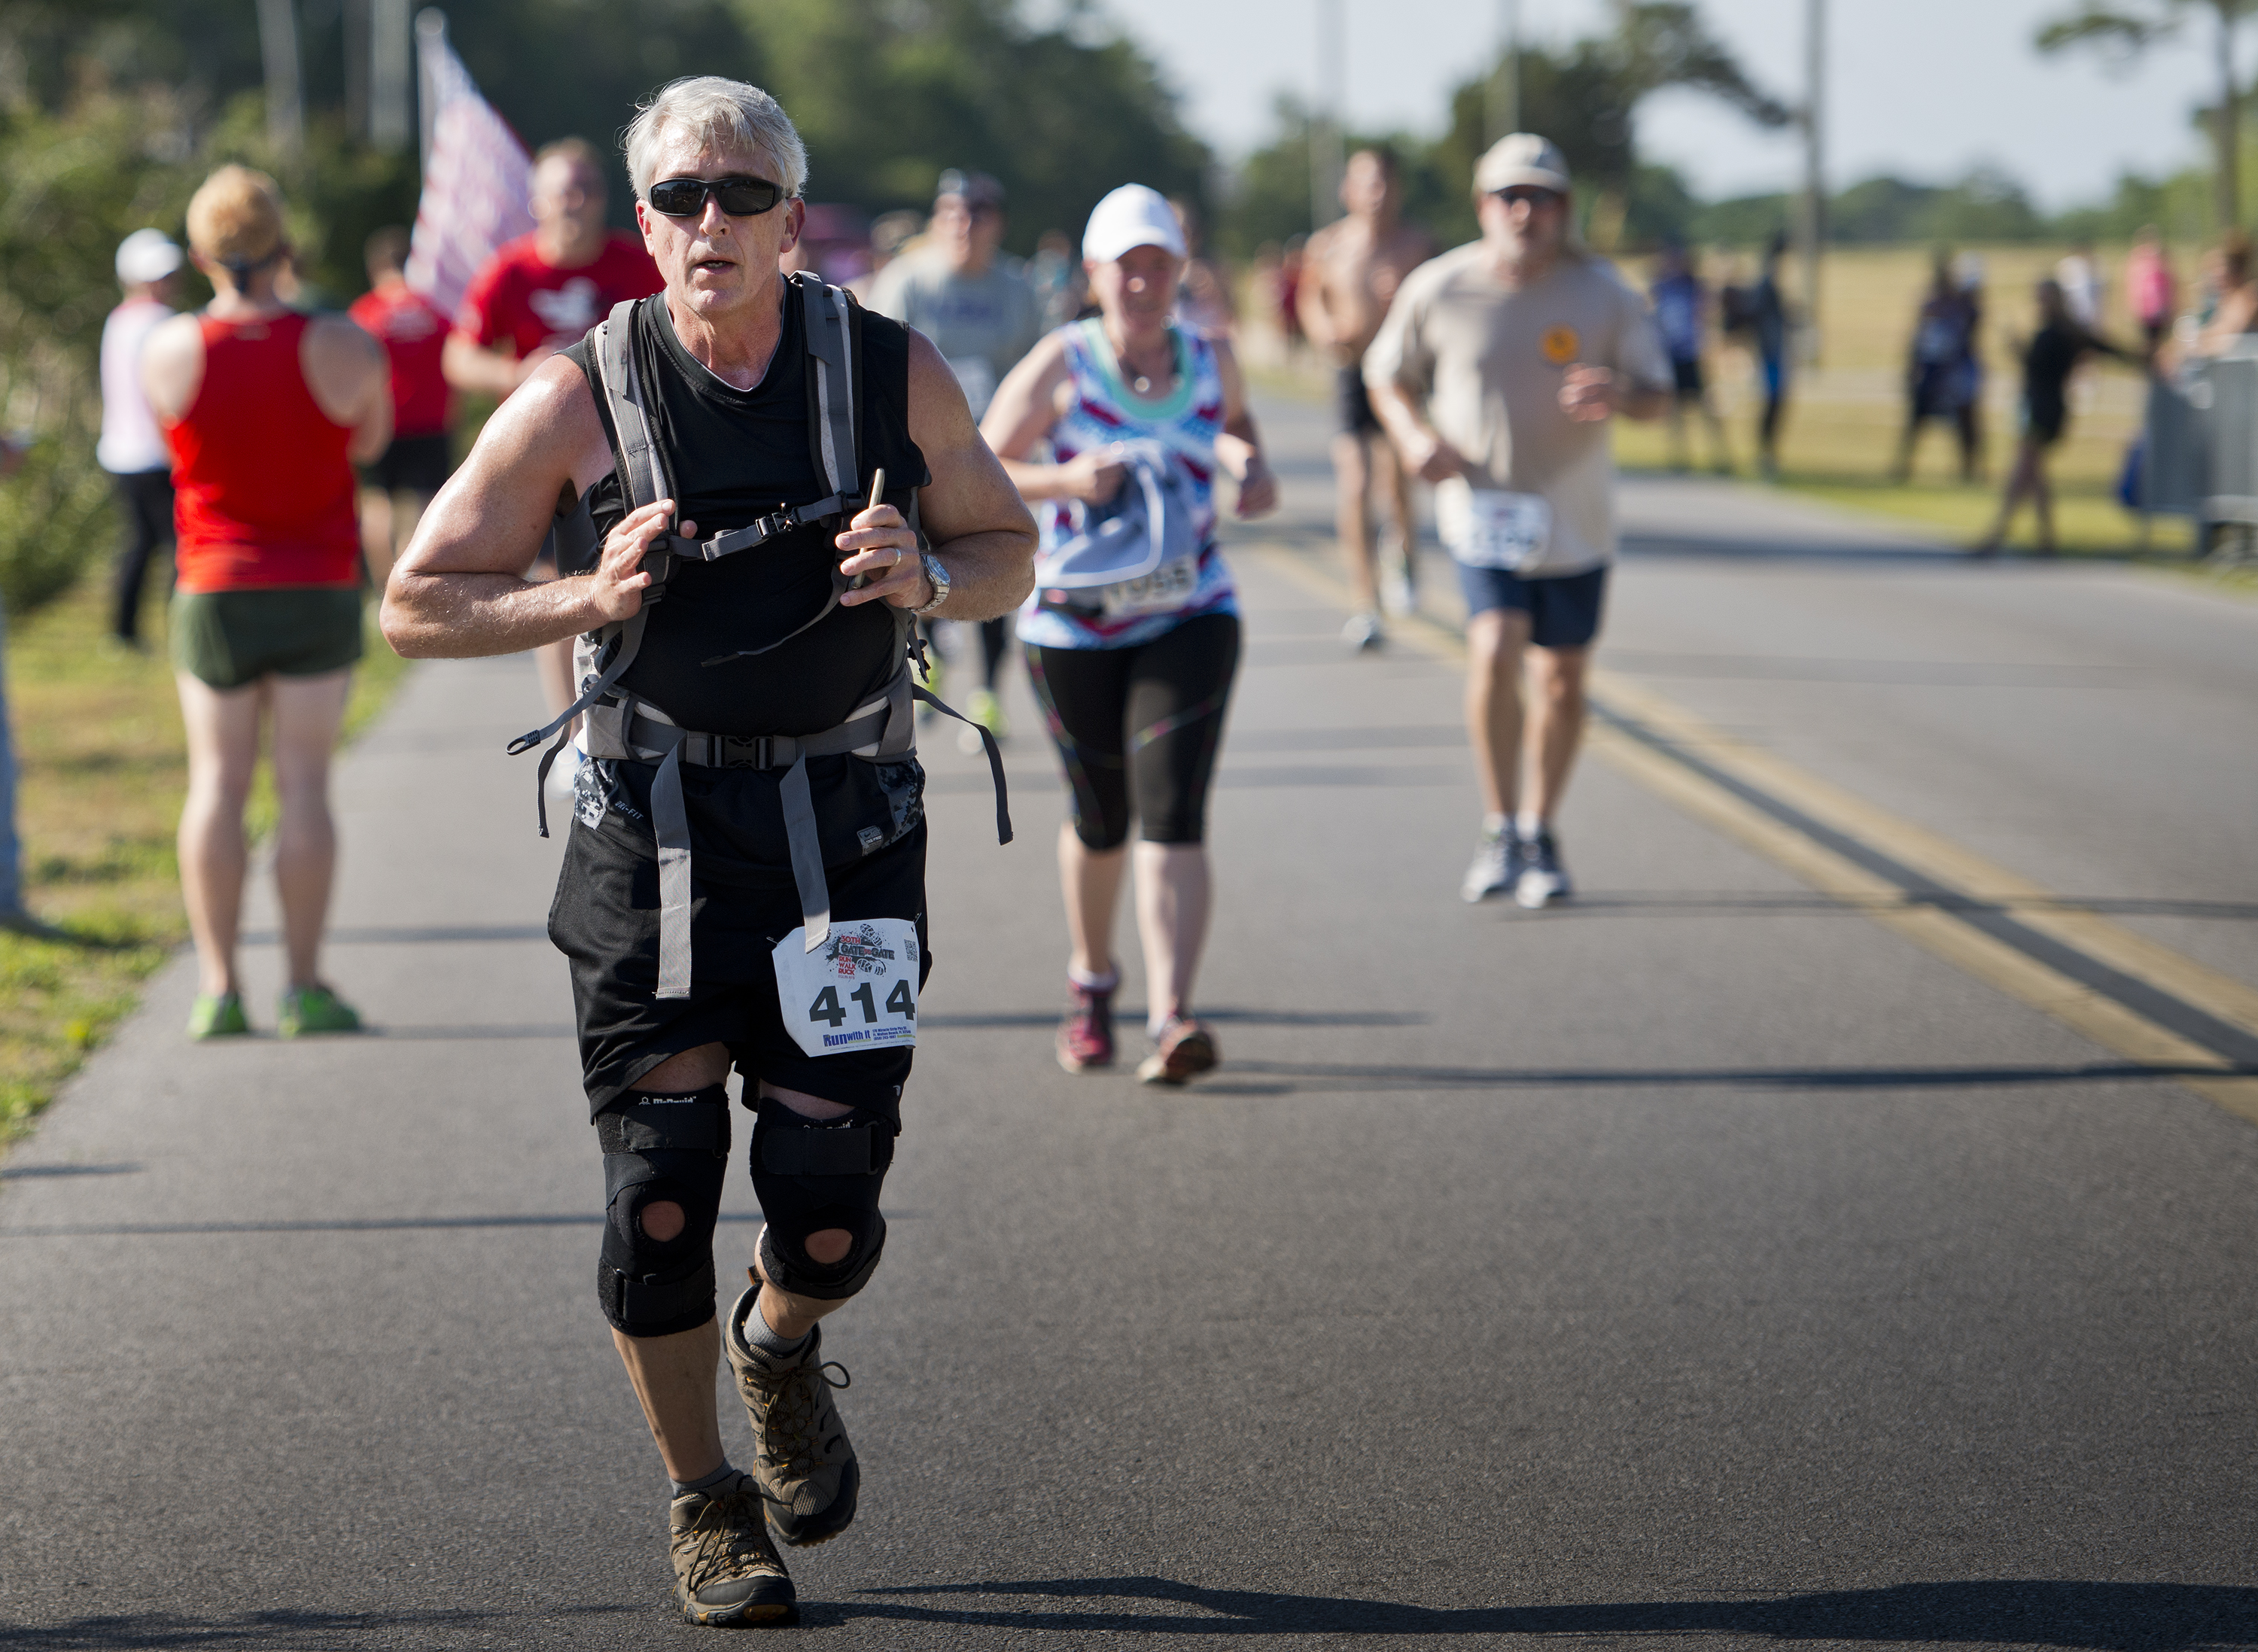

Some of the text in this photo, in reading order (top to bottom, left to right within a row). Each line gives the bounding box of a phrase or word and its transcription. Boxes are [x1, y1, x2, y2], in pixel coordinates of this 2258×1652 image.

[615, 801, 644, 819] DRI-FIT
[841, 935, 861, 945] 30TH
[841, 944, 865, 957] GATE
[872, 948, 895, 960] GATE
[838, 962, 857, 970] WALK
[809, 979, 915, 1027] 414
